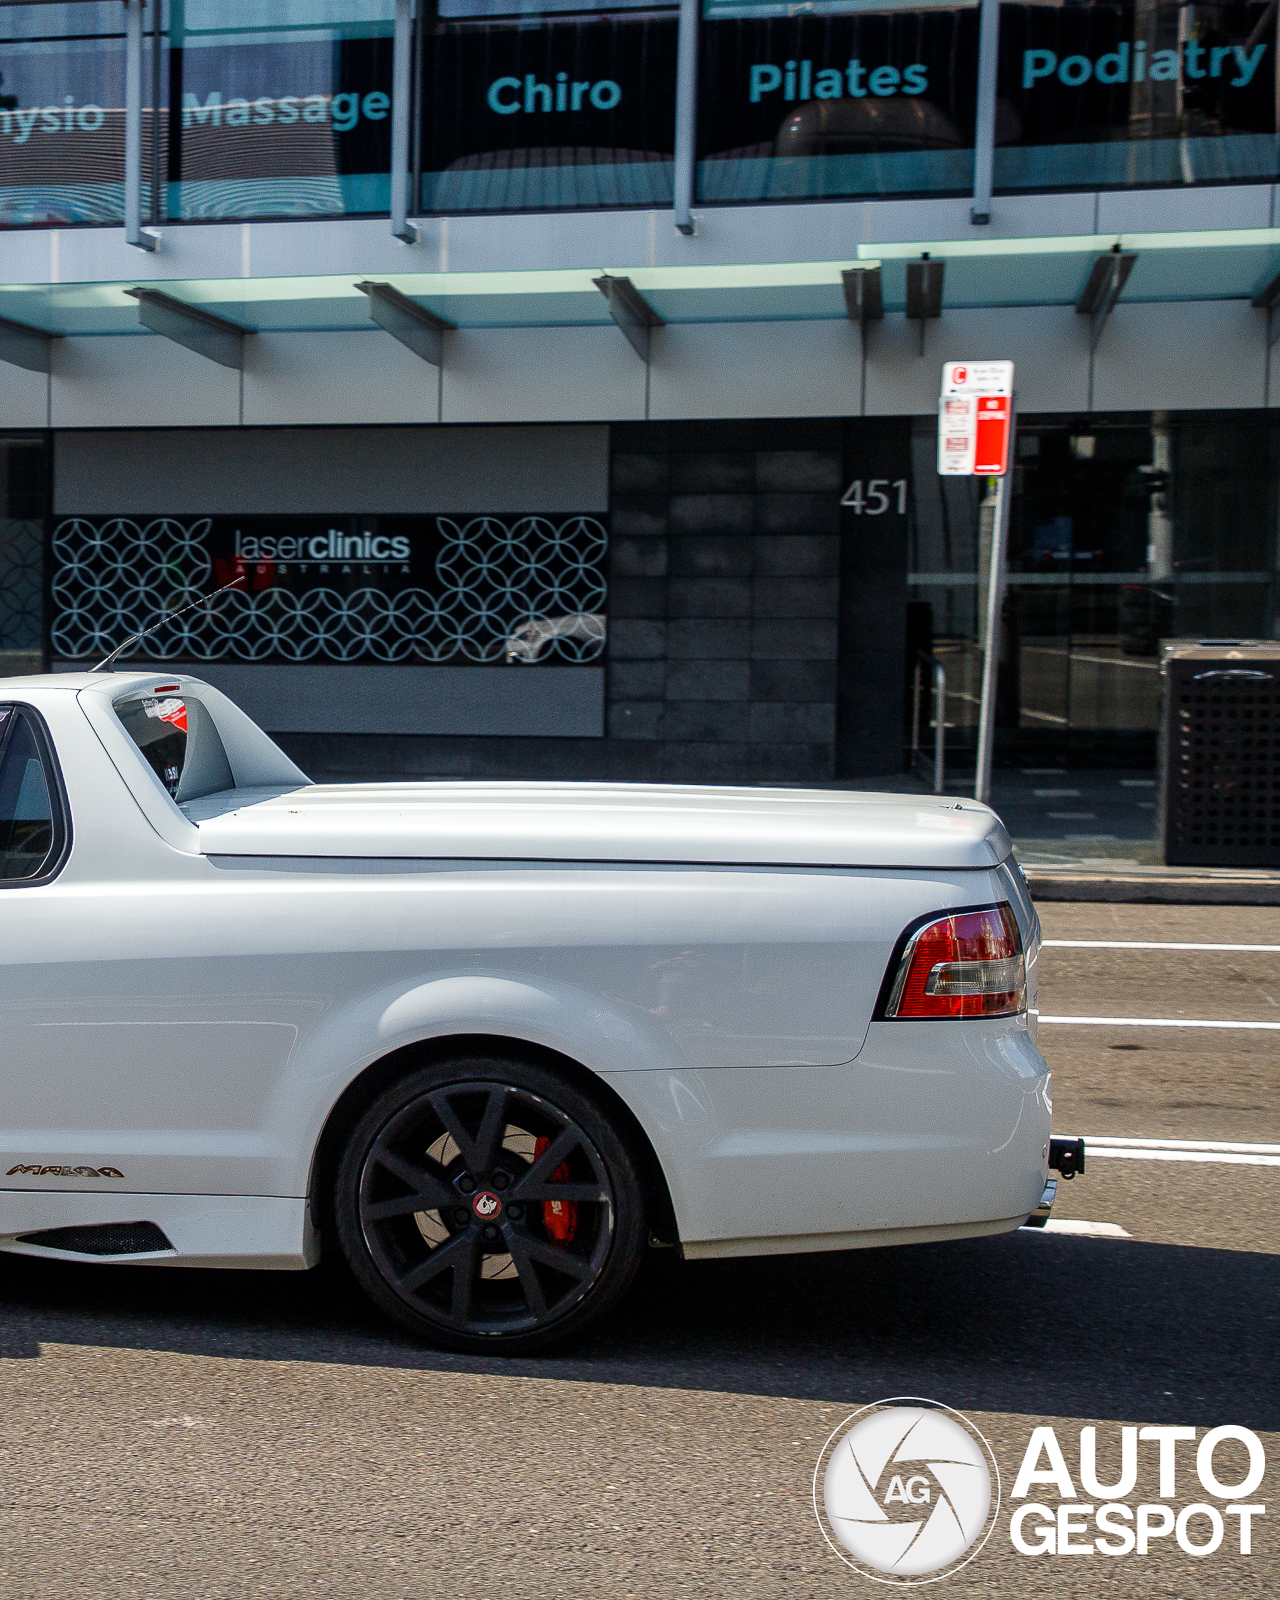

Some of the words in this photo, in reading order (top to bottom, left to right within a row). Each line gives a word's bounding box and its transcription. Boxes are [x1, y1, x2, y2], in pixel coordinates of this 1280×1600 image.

[749, 59, 929, 102] Pilates
[1022, 42, 1267, 88] Podiatry
[182, 91, 391, 132] Massage
[487, 71, 622, 115] Chiro
[840, 479, 907, 515] 451
[234, 529, 411, 559] laserclinics
[235, 564, 411, 574] AUSTRALIA
[5, 1164, 125, 1178] MALOO
